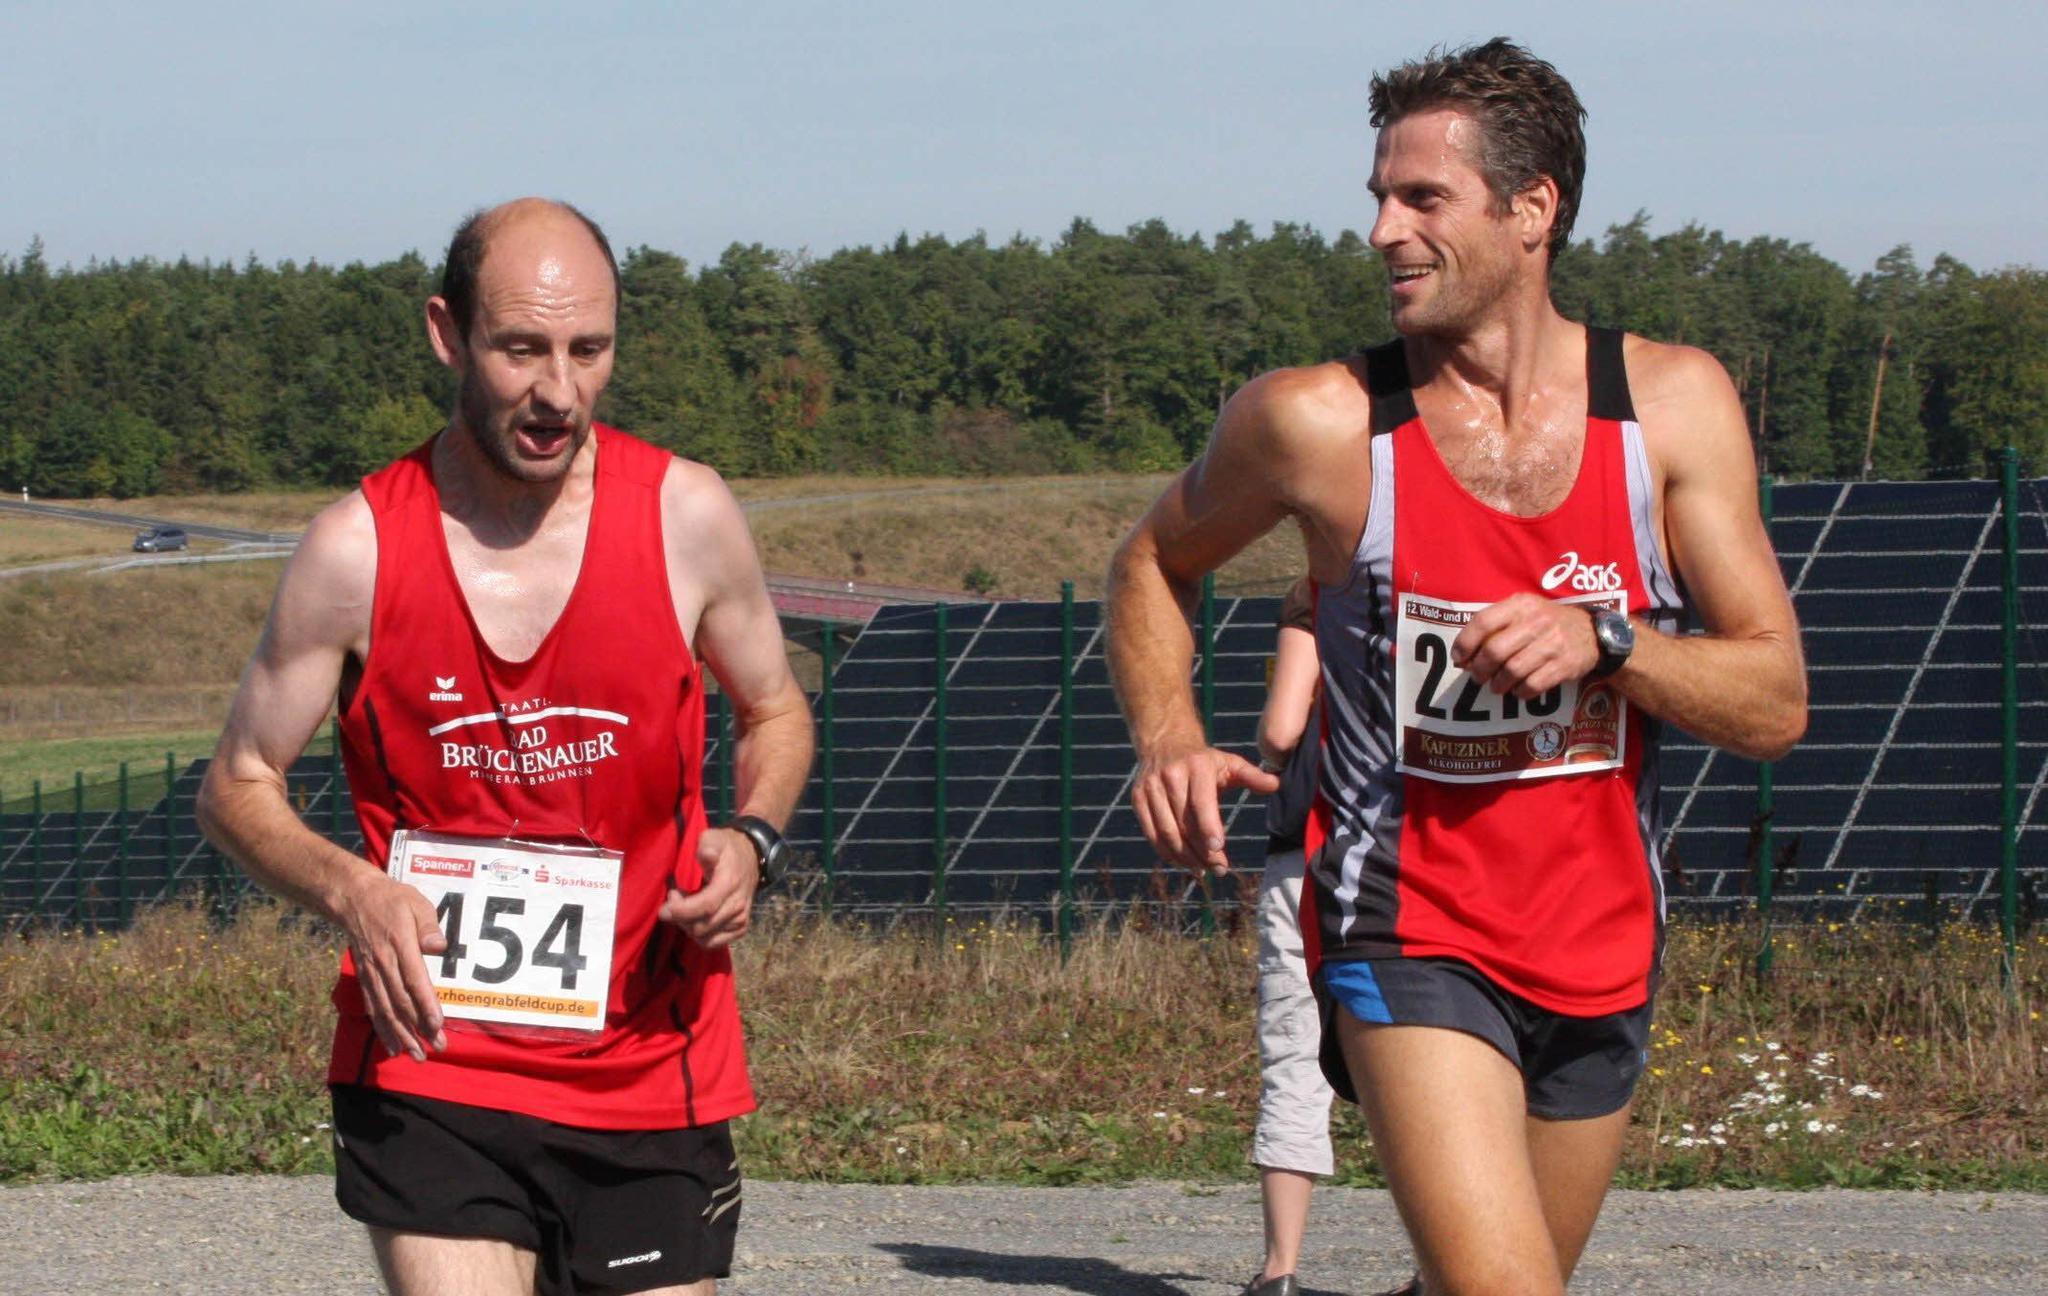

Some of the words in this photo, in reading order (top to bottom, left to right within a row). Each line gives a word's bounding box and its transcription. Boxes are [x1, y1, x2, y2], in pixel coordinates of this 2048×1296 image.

[1572, 561, 1622, 591] asics
[1420, 604, 1442, 619] Wald-
[1443, 612, 1461, 622] und
[429, 690, 463, 702] erima
[498, 697, 553, 713] TAATL.
[441, 731, 619, 774] BRÜCKENAUER
[1421, 733, 1512, 758] KAPUZINER
[1427, 757, 1502, 770] ALKOHOLFREI
[469, 766, 593, 786] MERABRUNNEN
[554, 875, 613, 890] Sparkasse
[421, 891, 588, 991] 454
